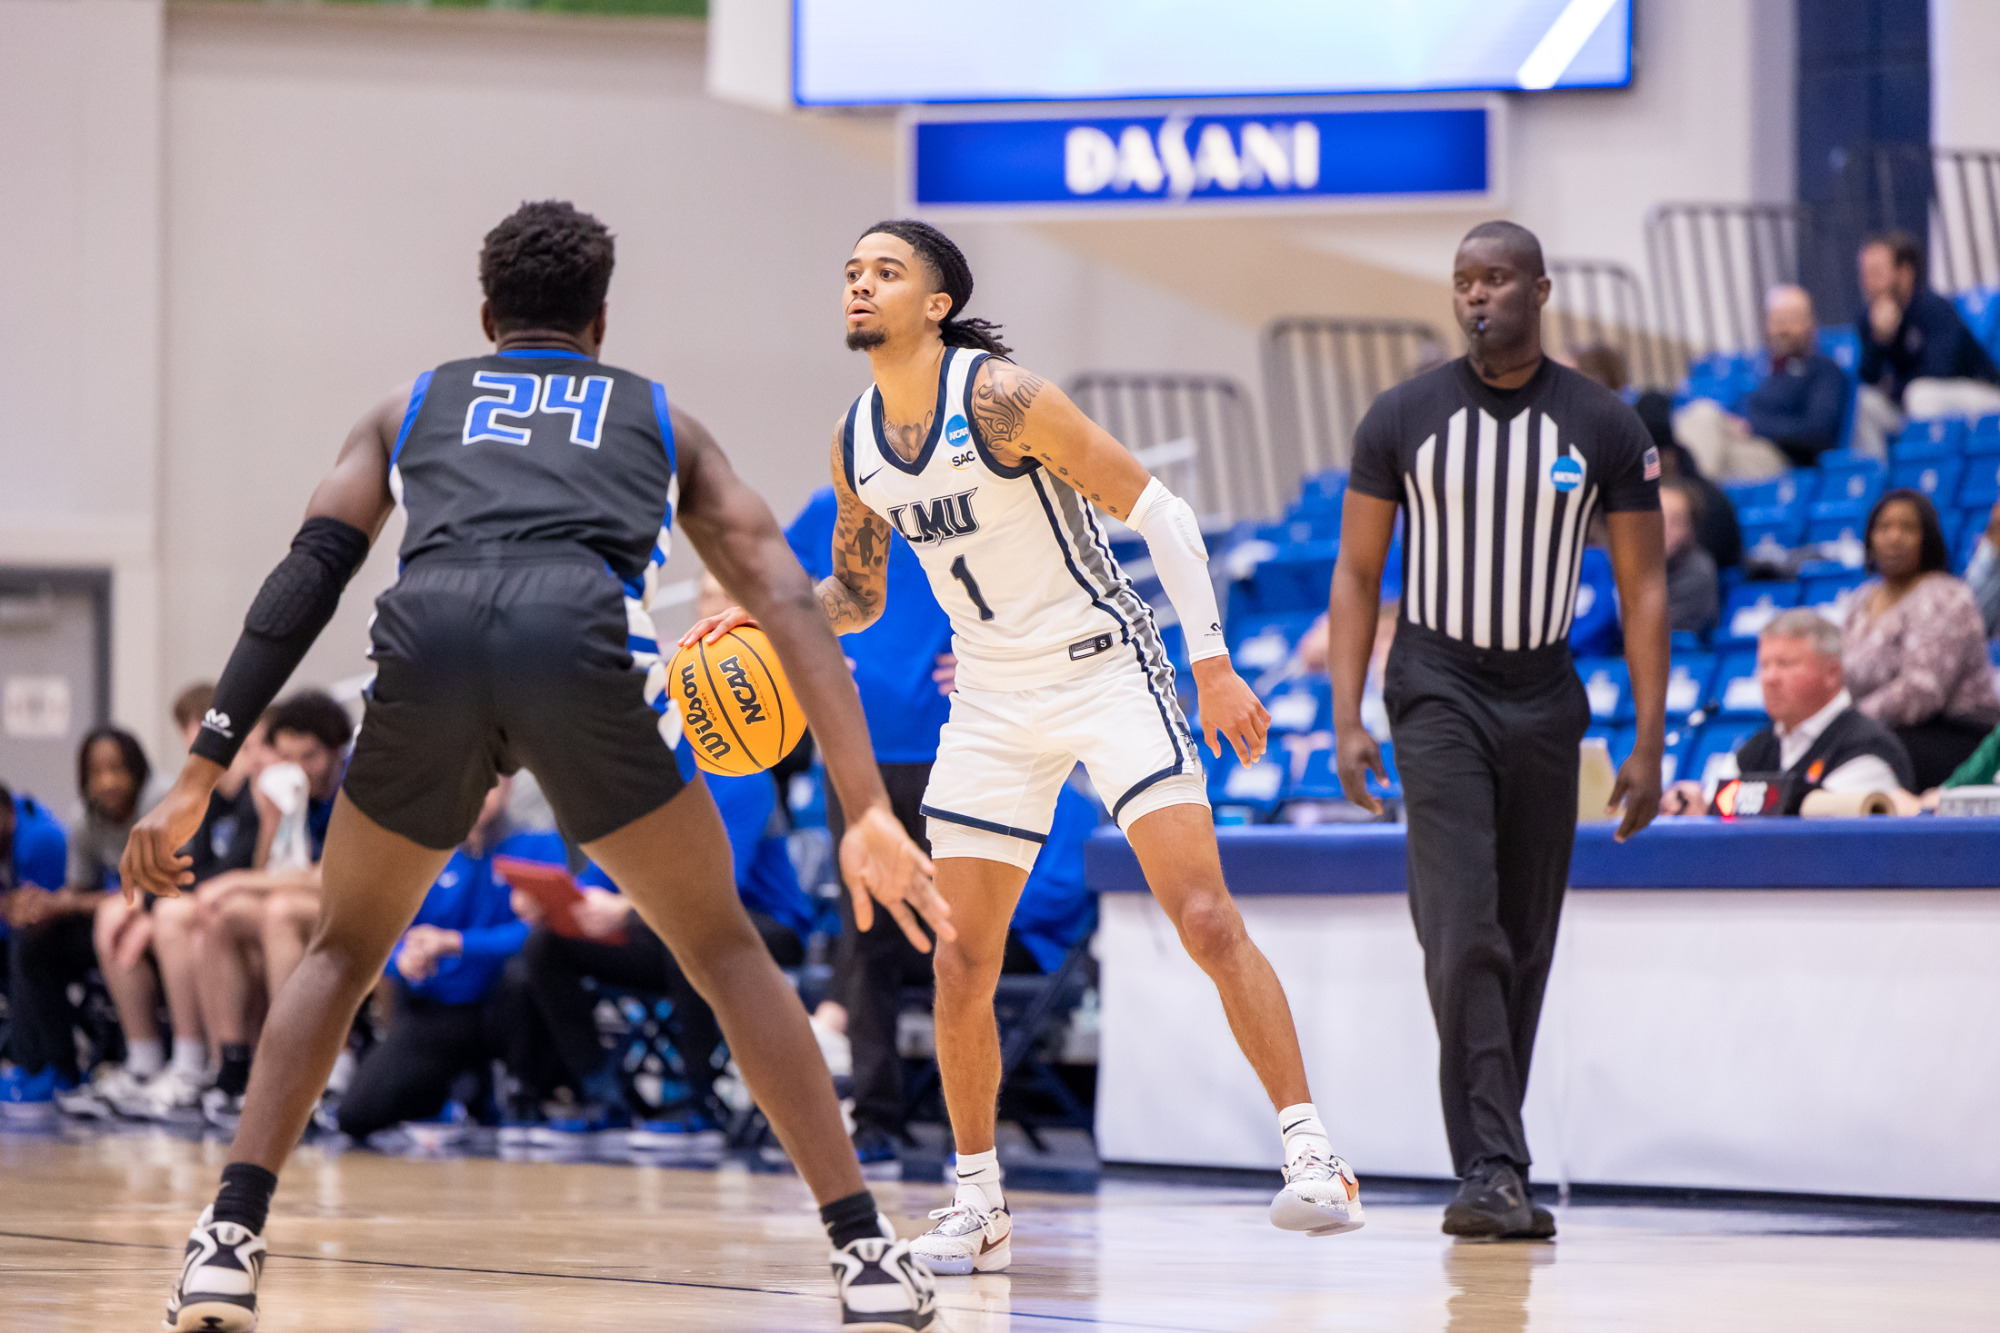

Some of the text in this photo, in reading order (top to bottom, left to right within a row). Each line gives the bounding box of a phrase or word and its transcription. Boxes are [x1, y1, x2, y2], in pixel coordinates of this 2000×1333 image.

[1064, 112, 1320, 204] DASANI
[462, 370, 614, 449] 24
[948, 426, 969, 441] NCAA
[951, 450, 976, 467] SAC
[887, 486, 980, 546] LMU
[949, 554, 995, 621] 1
[1099, 639, 1107, 648] S
[681, 662, 731, 760] Wilson
[717, 655, 766, 724] NCAA
